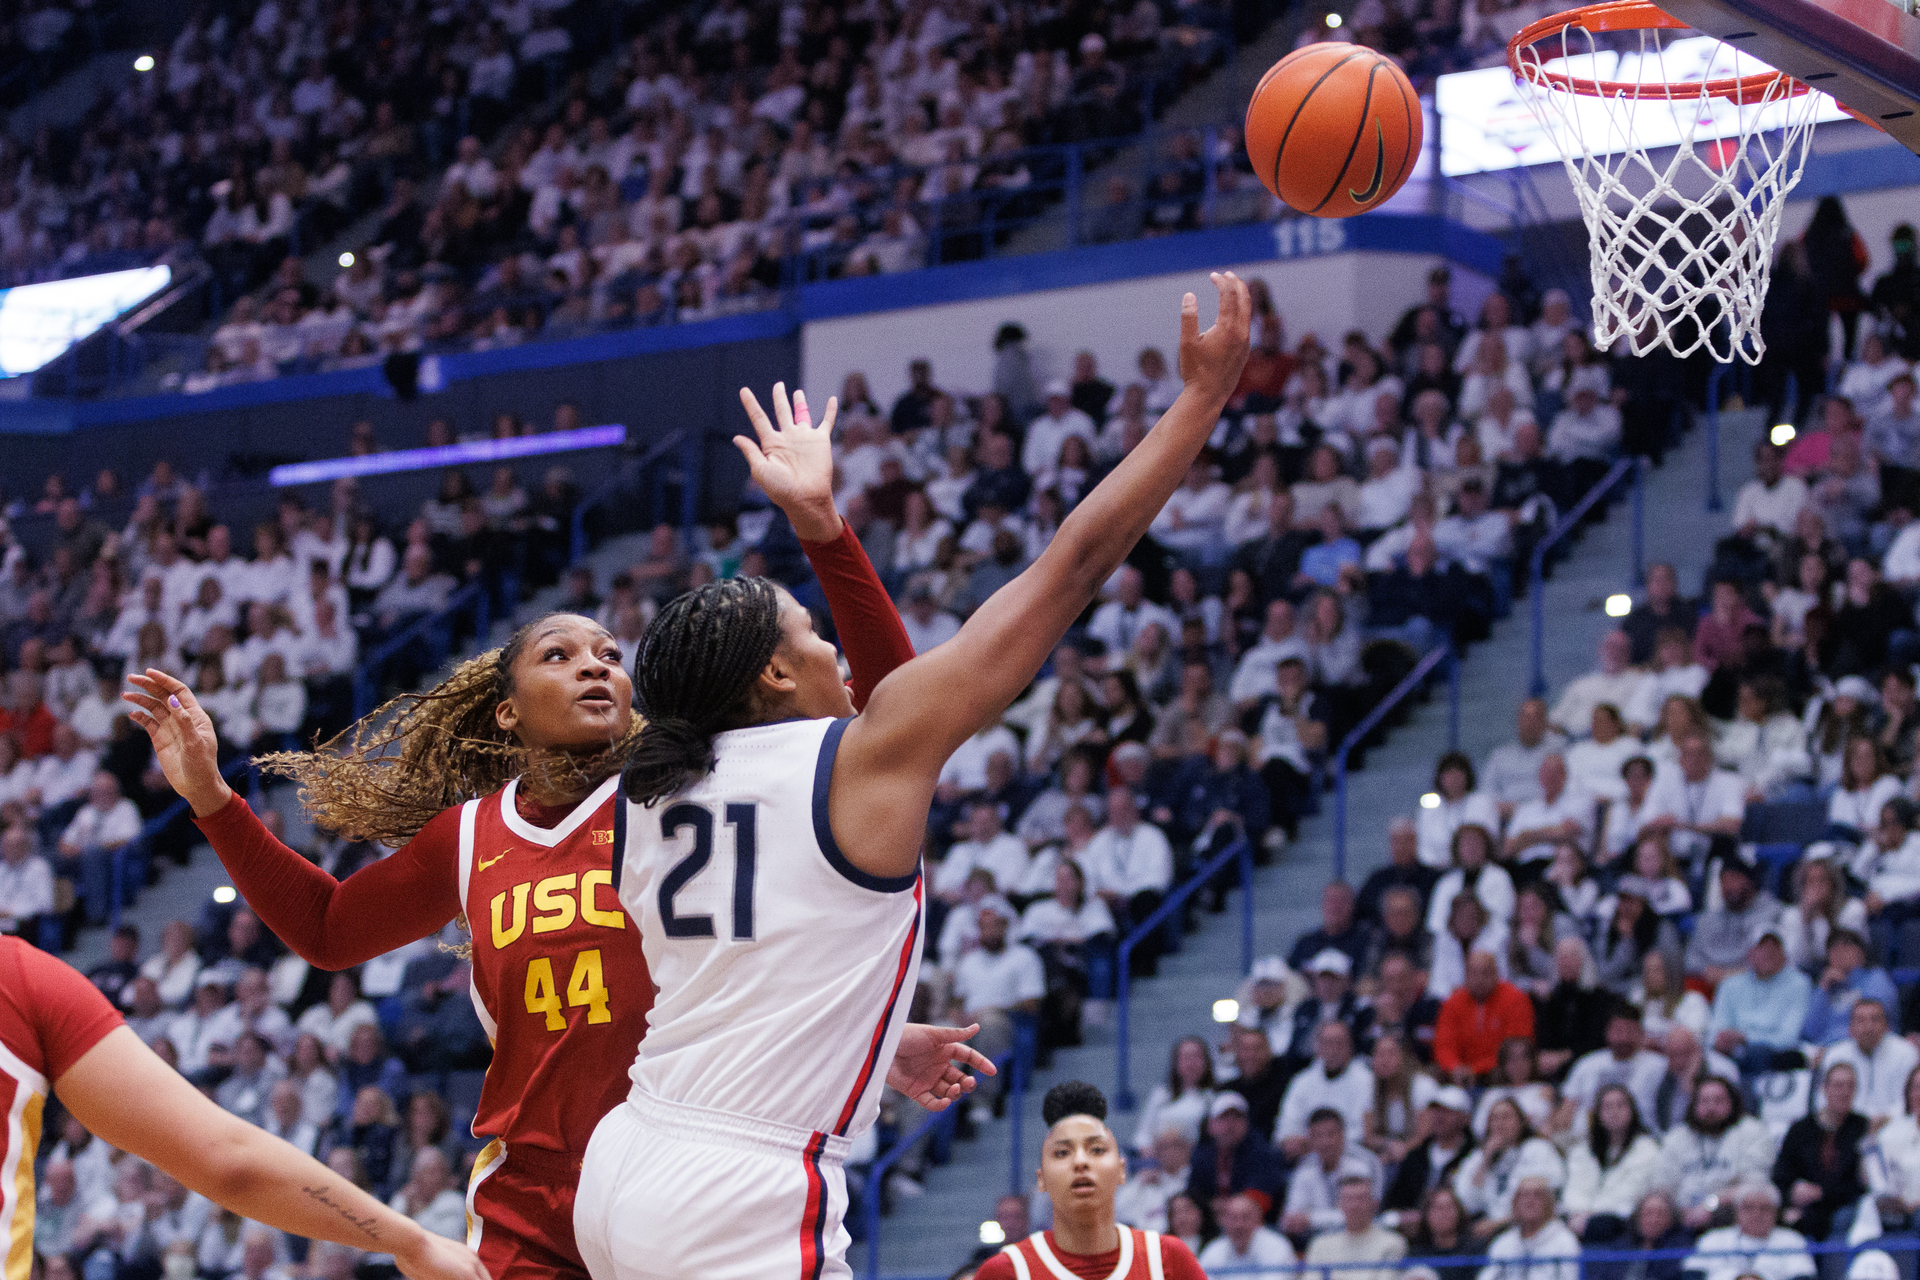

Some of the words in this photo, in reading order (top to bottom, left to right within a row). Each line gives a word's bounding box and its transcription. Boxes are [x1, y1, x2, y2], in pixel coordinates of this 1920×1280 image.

[1275, 217, 1346, 256] 115
[592, 829, 614, 845] B1
[658, 802, 757, 942] 21
[490, 869, 626, 950] USC
[524, 949, 613, 1032] 44
